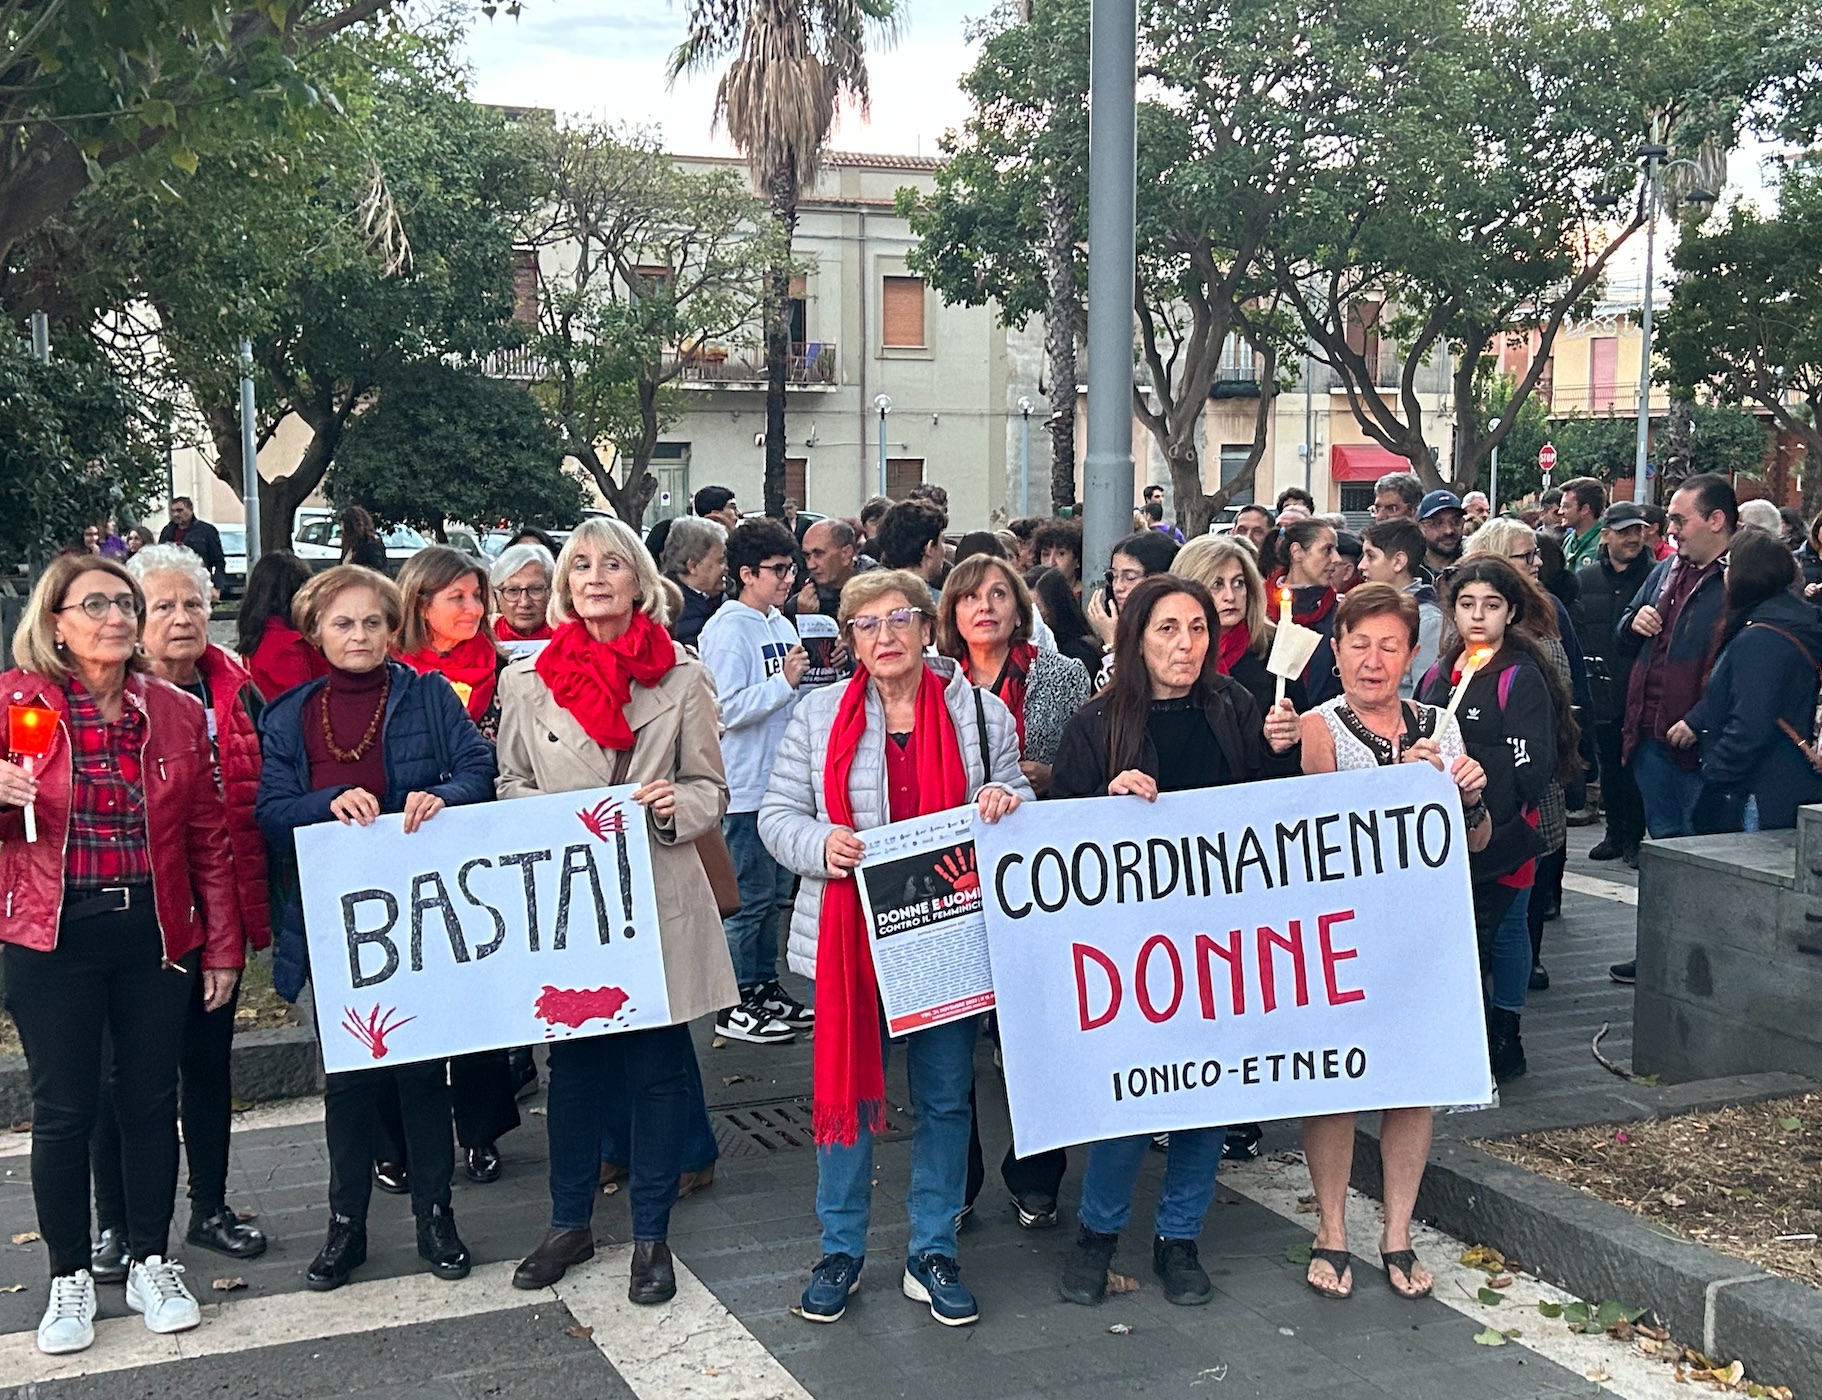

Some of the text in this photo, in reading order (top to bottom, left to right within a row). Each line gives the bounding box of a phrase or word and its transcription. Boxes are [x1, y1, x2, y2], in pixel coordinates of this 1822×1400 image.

[1540, 452, 1556, 463] STOP
[994, 803, 1451, 920] COORDINAMENTO
[340, 810, 636, 989] BASTA!
[877, 901, 930, 926] DONNE
[931, 898, 941, 911] E
[879, 917, 921, 935] CONTRO
[922, 915, 931, 924] IL
[1072, 909, 1366, 1031] DONNE
[1113, 1047, 1366, 1102] IONICO-ETNEO
